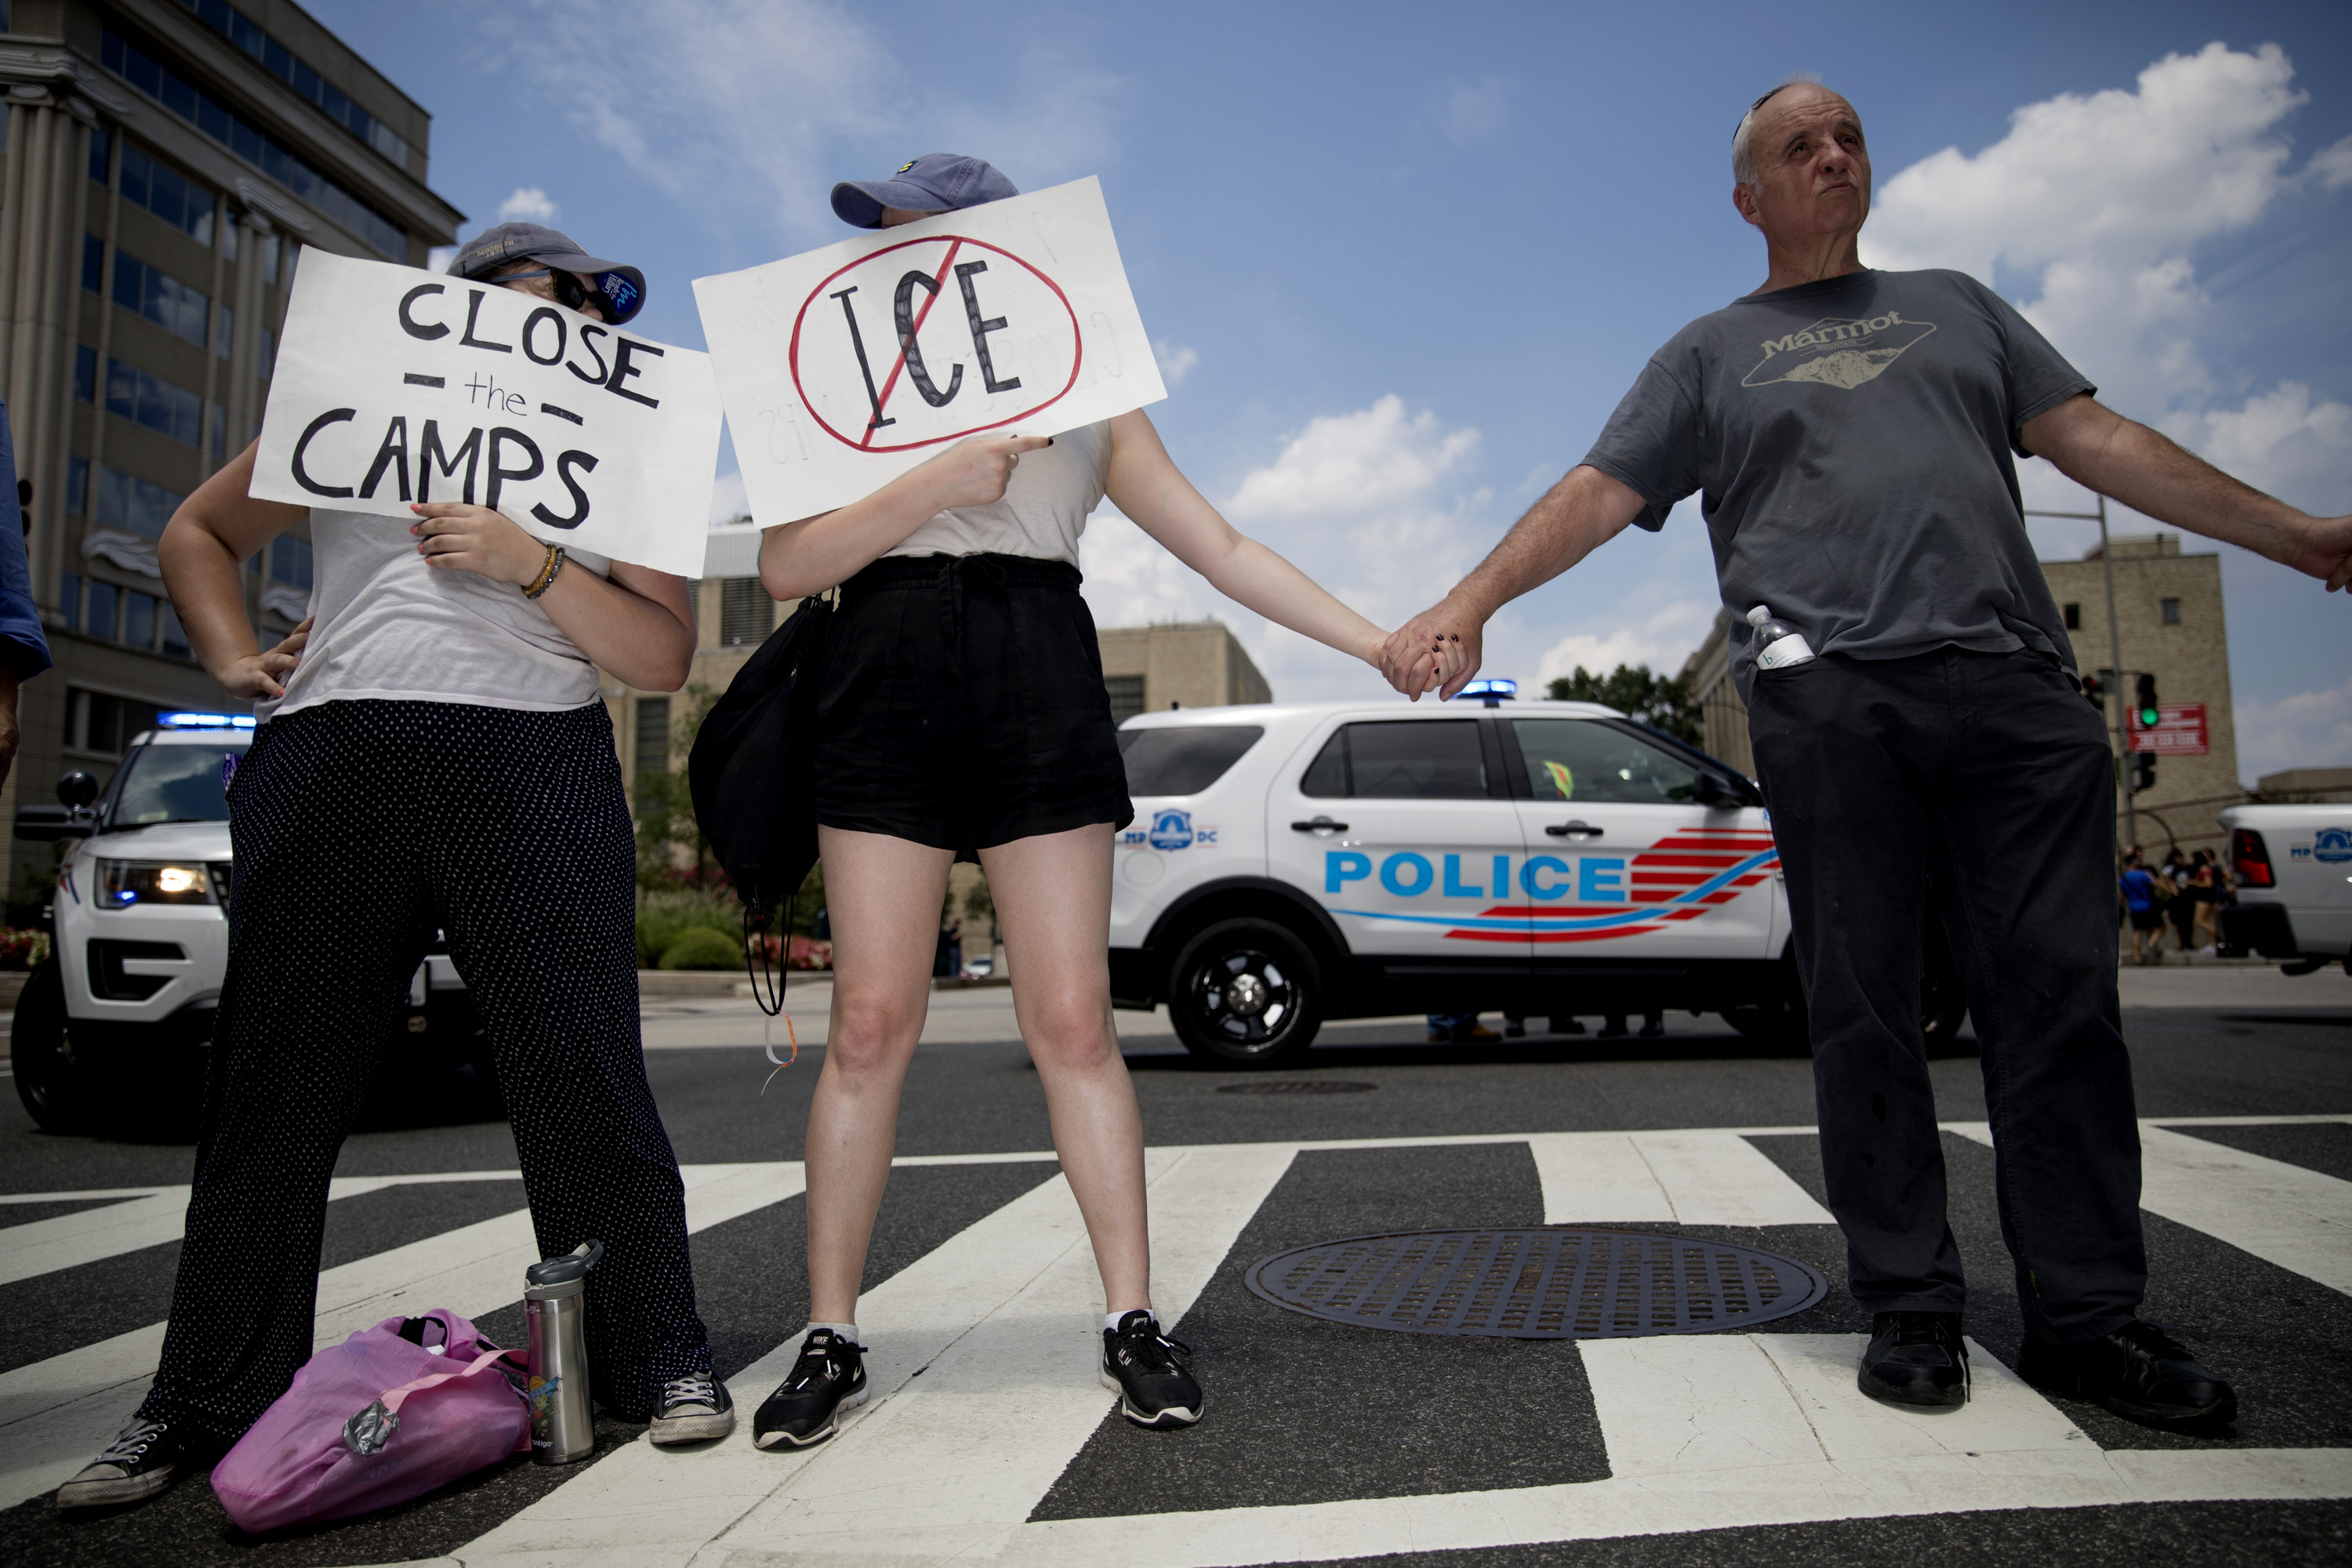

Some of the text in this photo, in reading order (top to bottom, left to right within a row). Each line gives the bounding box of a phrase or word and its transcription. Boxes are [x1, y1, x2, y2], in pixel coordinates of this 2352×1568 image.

[476, 239, 514, 257] REHOBOTH
[601, 273, 618, 294] Hillary
[613, 278, 625, 294] Ready
[617, 281, 637, 309] I'm
[397, 283, 665, 409] CLOSE
[829, 260, 1022, 430] ICE
[1761, 310, 1904, 360] Marmot
[1816, 339, 1857, 350] MOUNTAIN
[464, 372, 528, 417] the
[291, 408, 600, 531] CAMPS
[1124, 830, 1218, 844] MP DC
[1324, 851, 1626, 902] POLICE
[812, 1335, 829, 1345] NIKE
